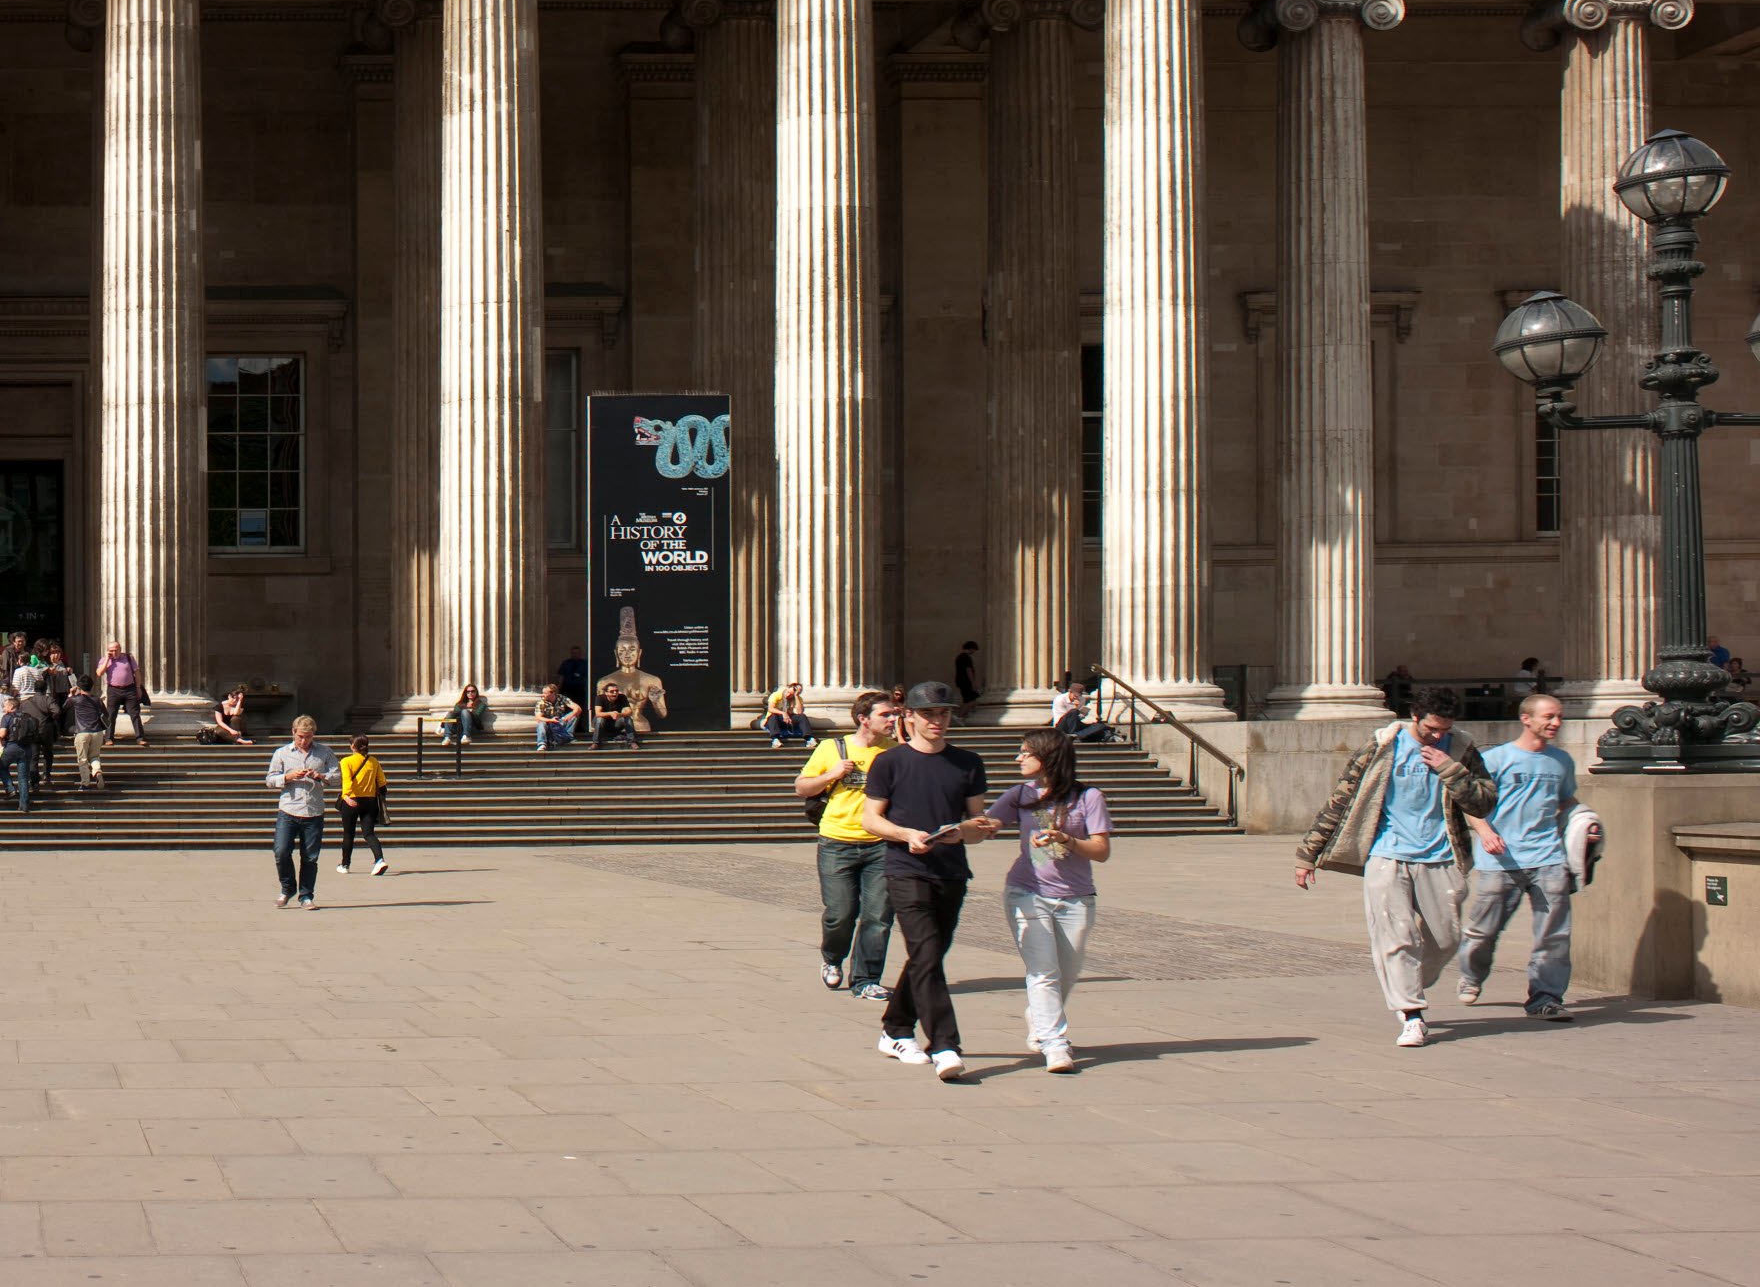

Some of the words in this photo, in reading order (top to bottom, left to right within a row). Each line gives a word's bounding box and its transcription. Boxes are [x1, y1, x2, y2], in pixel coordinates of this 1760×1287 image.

[610, 515, 621, 525] A
[610, 526, 688, 539] HISTORY
[640, 540, 659, 549] OF
[661, 540, 687, 549] THE
[641, 551, 708, 564] WORLD
